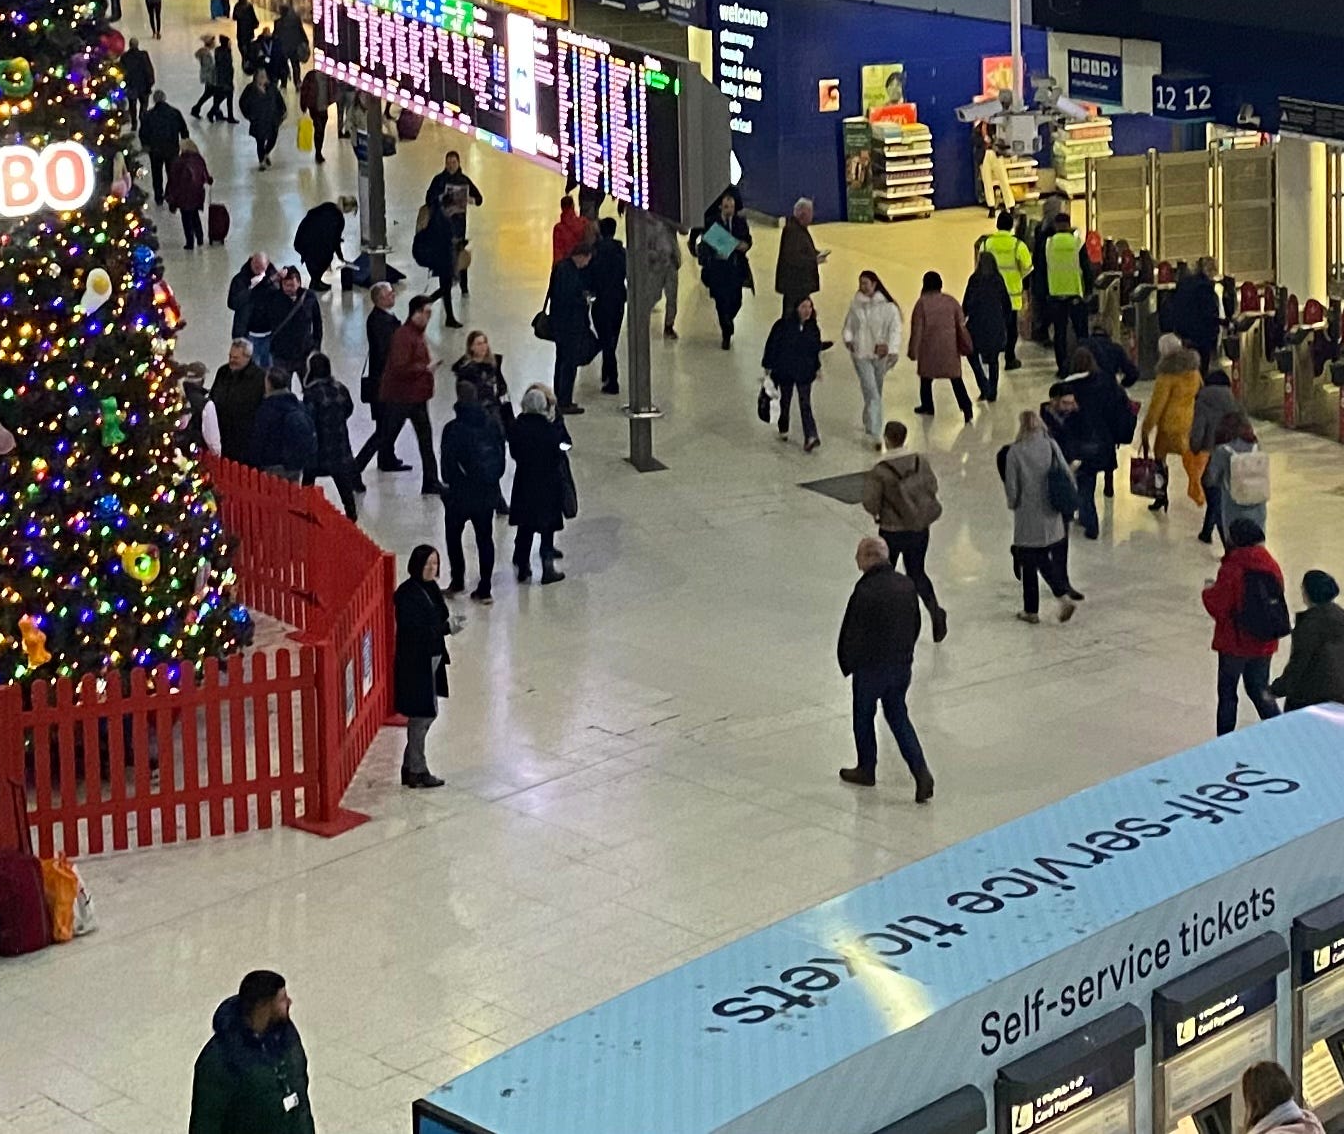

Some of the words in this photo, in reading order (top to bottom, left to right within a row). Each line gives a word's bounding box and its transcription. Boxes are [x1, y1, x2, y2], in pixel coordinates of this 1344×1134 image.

[719, 2, 768, 28] welcome
[1156, 85, 1177, 111] 12
[1184, 84, 1212, 111] 12
[946, 768, 1302, 915] Self-service
[981, 939, 1171, 1057] Self-service
[1178, 886, 1276, 958] tickets
[1197, 1019, 1214, 1036] Card
[1035, 1102, 1054, 1124] Card
[1054, 1086, 1093, 1115] Payments
